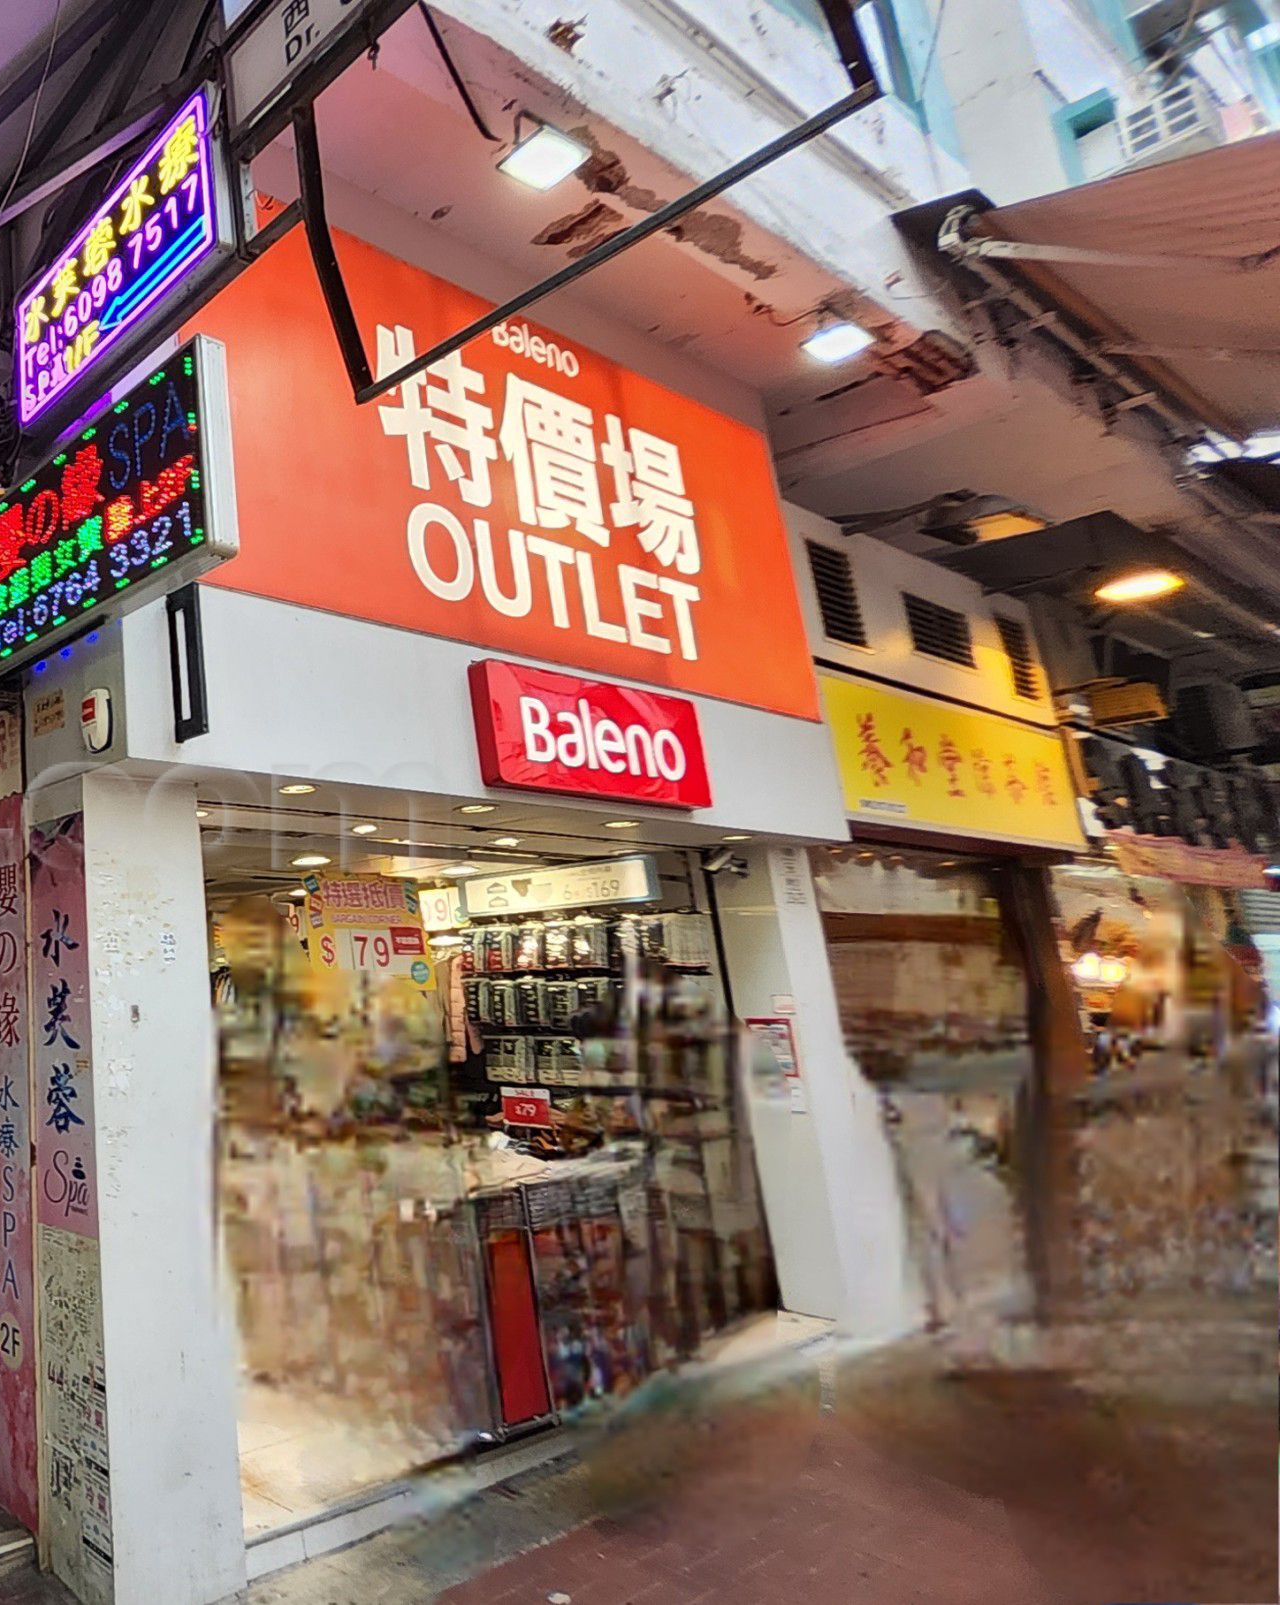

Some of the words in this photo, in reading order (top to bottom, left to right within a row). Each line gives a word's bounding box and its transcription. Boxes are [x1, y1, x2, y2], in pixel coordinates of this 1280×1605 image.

[285, 22, 320, 66] Dr.
[491, 320, 580, 378] Baleno
[108, 380, 192, 490] SPA
[375, 323, 702, 575] 特價場
[406, 501, 702, 662] OUTLET
[519, 696, 686, 782] Baleno
[321, 935, 336, 968] $
[353, 936, 390, 968] 79
[39, 909, 84, 1133] 水芙蓉
[44, 1150, 89, 1217] Spa
